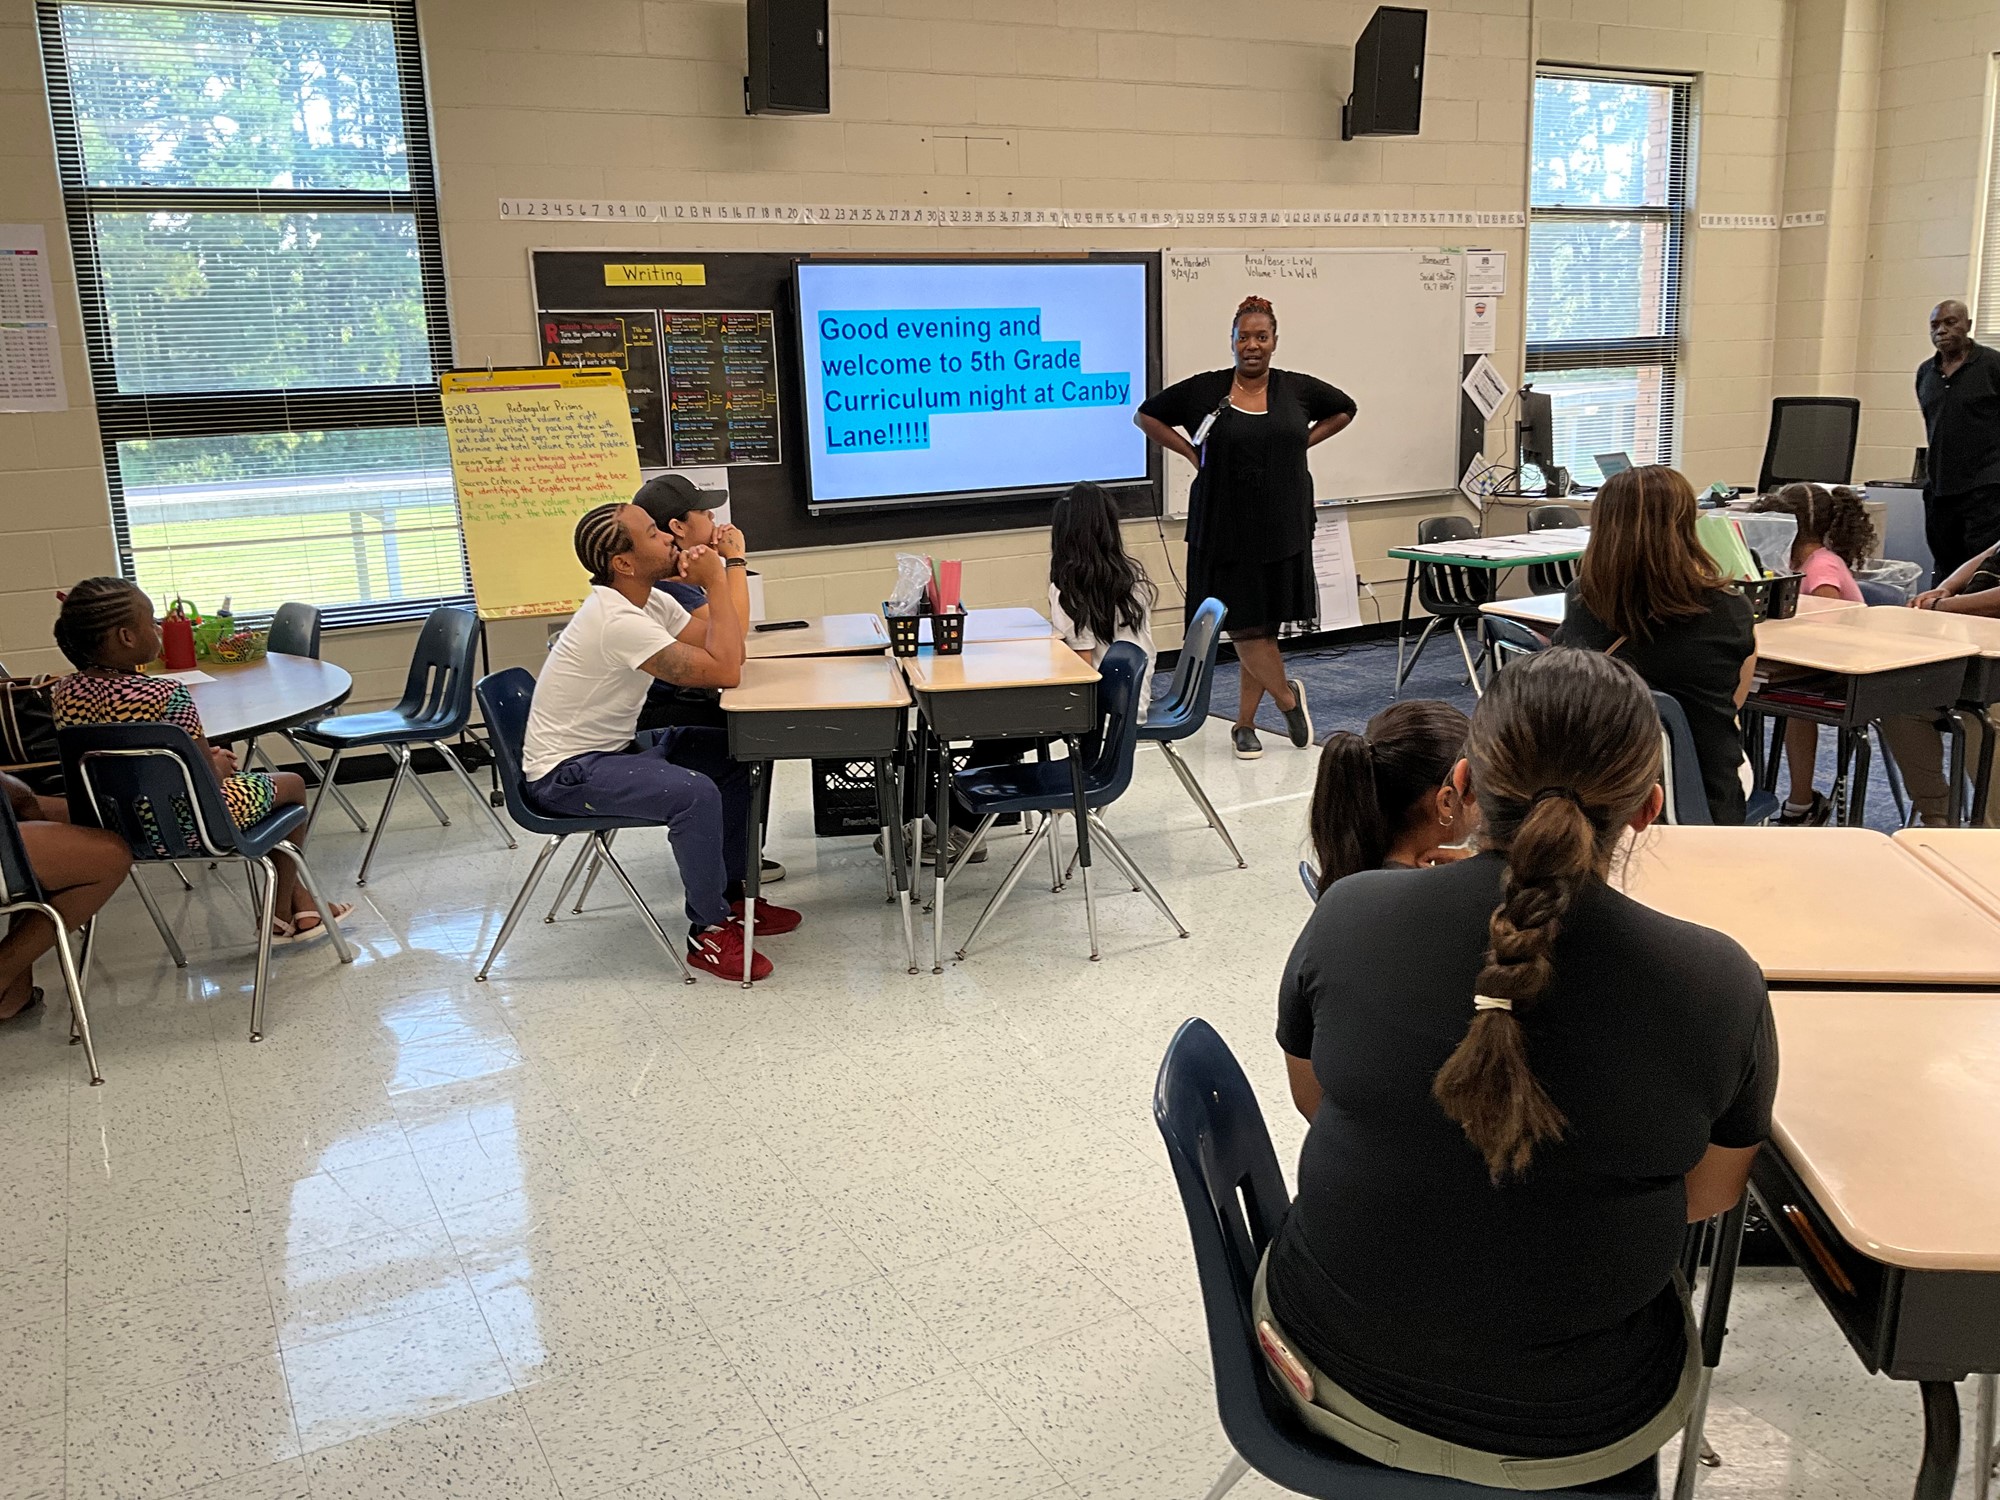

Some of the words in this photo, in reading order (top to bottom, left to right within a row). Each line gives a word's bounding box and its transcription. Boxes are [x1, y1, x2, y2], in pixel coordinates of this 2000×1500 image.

[502, 202, 509, 215] 0
[528, 204, 535, 215] 2
[541, 203, 548, 215] 3
[554, 204, 562, 215] 4
[567, 204, 574, 216] 5
[580, 204, 586, 216] 6
[592, 204, 599, 216] 7
[608, 205, 614, 216] 8
[620, 205, 626, 217] 9
[636, 205, 646, 217] 10
[660, 206, 667, 218] 11
[675, 206, 684, 218] 12
[690, 206, 698, 218] 13
[702, 206, 712, 218] 14
[718, 206, 728, 218] 15
[732, 207, 742, 218] 16
[747, 207, 756, 218] 17
[762, 207, 770, 218] 18
[775, 208, 782, 218] 19
[788, 208, 798, 218] 20
[806, 208, 813, 218] 21
[820, 208, 830, 220] 22
[835, 208, 845, 220] 23
[850, 209, 858, 220] 24
[862, 209, 872, 220] 25
[876, 209, 886, 220] 26
[889, 210, 898, 220] 27
[902, 210, 910, 221] 28
[914, 210, 922, 221] 29
[928, 210, 938, 222] 30
[622, 266, 682, 285] Writing
[1245, 266, 1272, 277] Volume
[1420, 272, 1435, 281] Social
[820, 318, 888, 340] Good
[897, 316, 991, 342] evening
[1000, 315, 1040, 336] and
[822, 354, 931, 376] welcome
[940, 352, 962, 373] to
[970, 350, 1005, 372] 5th
[1014, 348, 1080, 370] Grade
[825, 387, 960, 412] Curriculum
[969, 384, 1027, 411] night
[1034, 383, 1054, 403] at
[1062, 380, 1130, 406] Canby
[507, 402, 550, 417] Rectangular
[554, 400, 583, 410] Prisms
[489, 415, 532, 427] Investigate
[537, 414, 561, 422] volume
[579, 411, 597, 423] right
[455, 425, 496, 437] rectangular
[503, 427, 528, 436] prisms
[532, 424, 540, 433] by
[546, 424, 574, 435] packing
[598, 420, 614, 430] with
[828, 421, 928, 448] Lane!!!!!
[457, 445, 492, 453] determine
[537, 442, 564, 450] volume
[579, 440, 596, 449] solve
[499, 434, 526, 443] without
[531, 435, 547, 445] gaps
[609, 450, 618, 458] to
[511, 464, 520, 472] of
[459, 479, 489, 487] Success
[464, 488, 474, 498] by
[479, 486, 520, 499] identifying
[520, 485, 533, 493] the
[538, 484, 566, 496] lengths
[465, 501, 472, 510] I
[500, 498, 518, 508] find
[521, 498, 536, 507] the
[542, 496, 570, 506] volume
[576, 495, 585, 505] by
[466, 512, 480, 521] the
[485, 511, 512, 525] length
[526, 509, 540, 517] the
